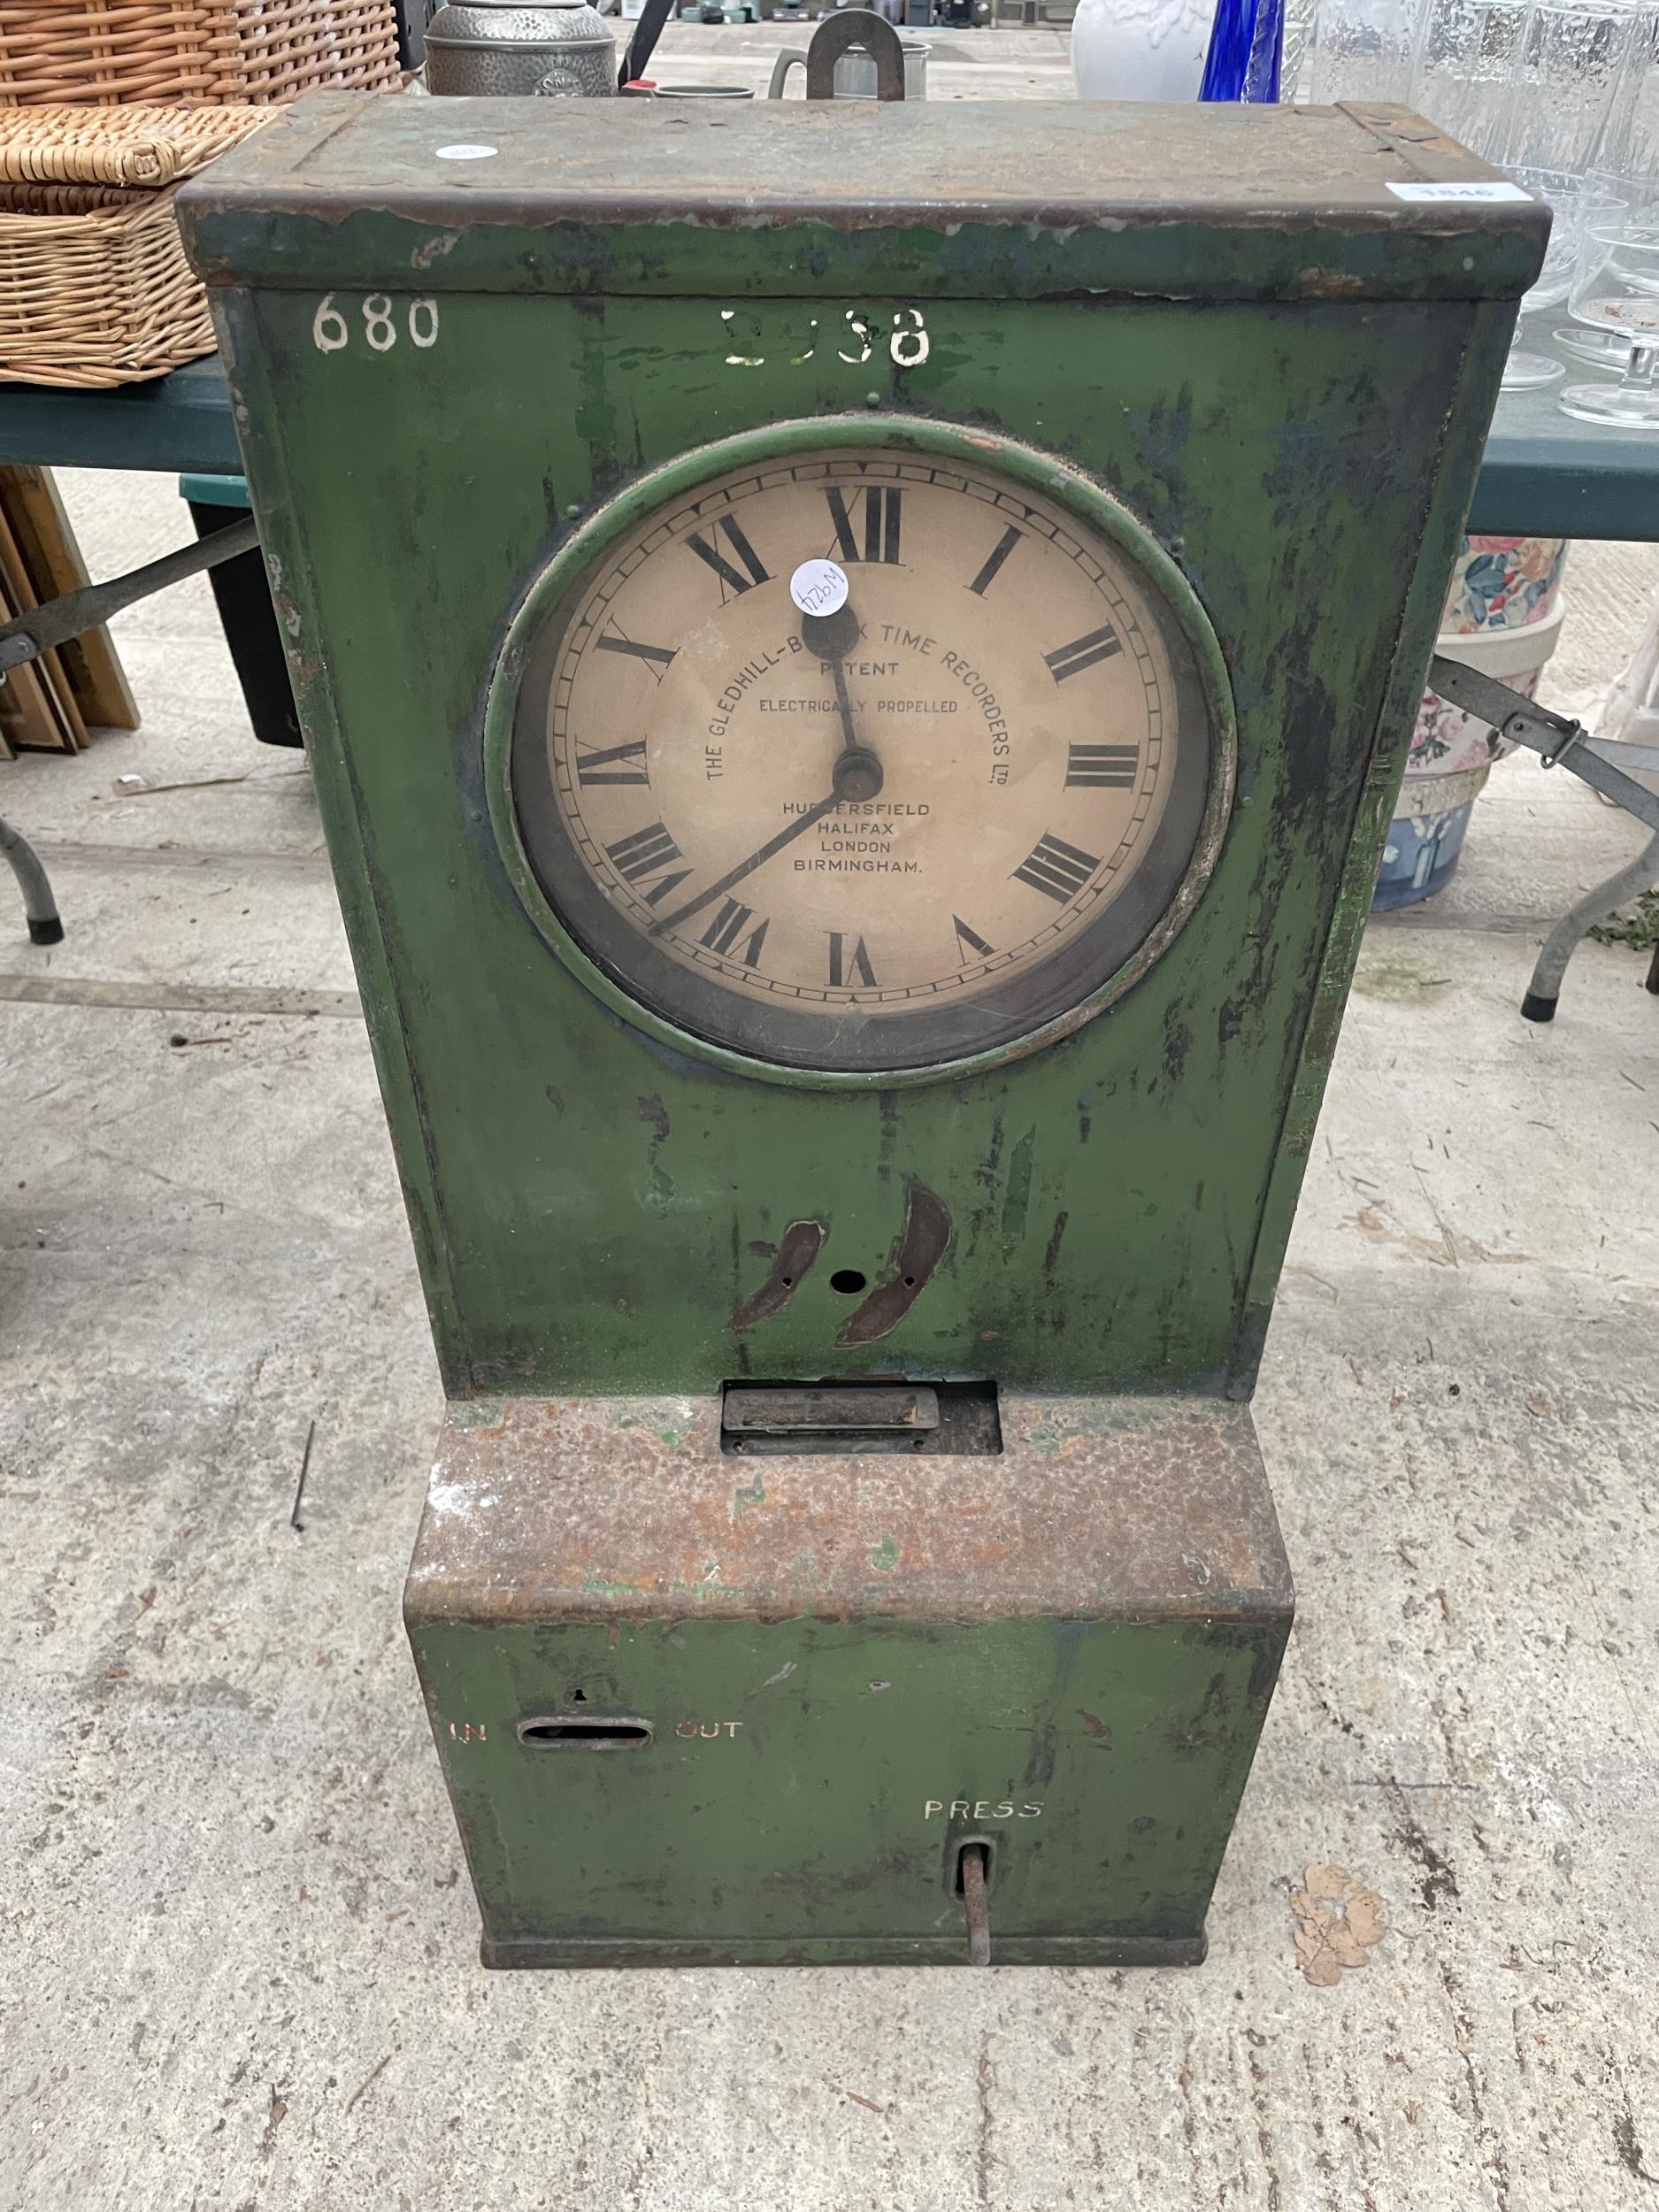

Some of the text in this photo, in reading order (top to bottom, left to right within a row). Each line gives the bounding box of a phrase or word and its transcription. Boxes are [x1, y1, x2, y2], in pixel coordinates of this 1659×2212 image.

[313, 291, 440, 354] 680
[817, 485, 910, 566] XII
[680, 511, 778, 609] XI
[963, 521, 1031, 600] I
[592, 612, 681, 687] X
[820, 662, 899, 676] PTENT
[1040, 617, 1125, 689] II
[705, 745, 724, 780] THE
[880, 625, 938, 656] TIME
[940, 650, 1010, 757] RECORDERS
[759, 699, 957, 713] ELECTRICALY PROPELLED
[575, 734, 651, 791] IX
[1063, 740, 1141, 795] III
[783, 803, 930, 816] HUERSFIELD
[818, 823, 895, 834] HALIFAX
[601, 815, 695, 910] VIII
[794, 859, 923, 873] BIRMINGHAM.
[821, 841, 891, 853] LONDON
[693, 892, 770, 971] VII
[822, 930, 884, 988] VI
[952, 913, 1002, 968] V
[447, 1722, 487, 1745] IN
[675, 1722, 743, 1739] OUT
[924, 1800, 1045, 1820] PRESS
